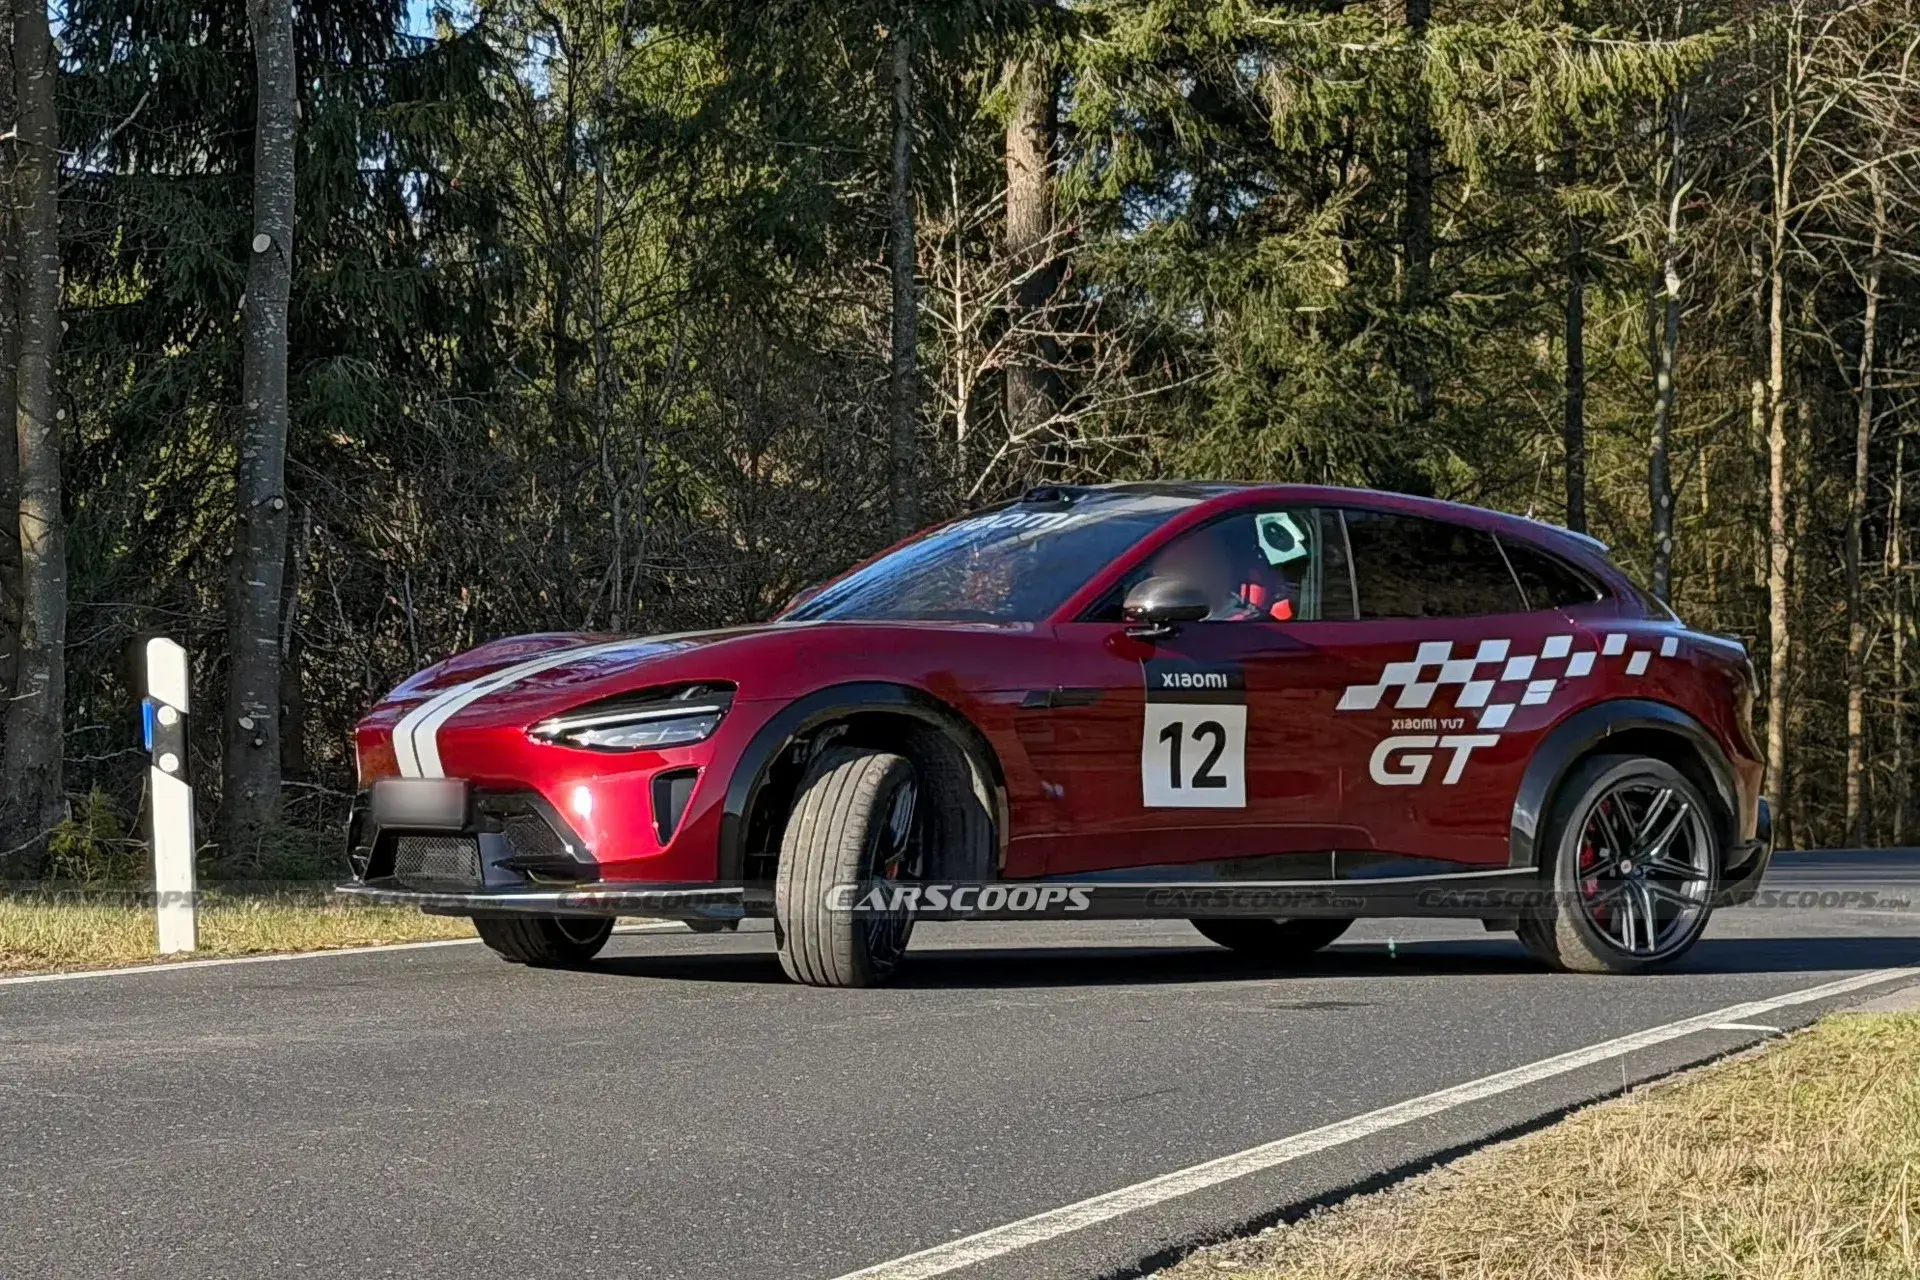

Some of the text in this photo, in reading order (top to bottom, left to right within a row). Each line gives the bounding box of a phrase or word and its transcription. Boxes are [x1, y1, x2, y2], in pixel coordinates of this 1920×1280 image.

[1440, 718, 1465, 730] YU7
[1159, 720, 1227, 789] 12
[1369, 734, 1501, 785] GT
